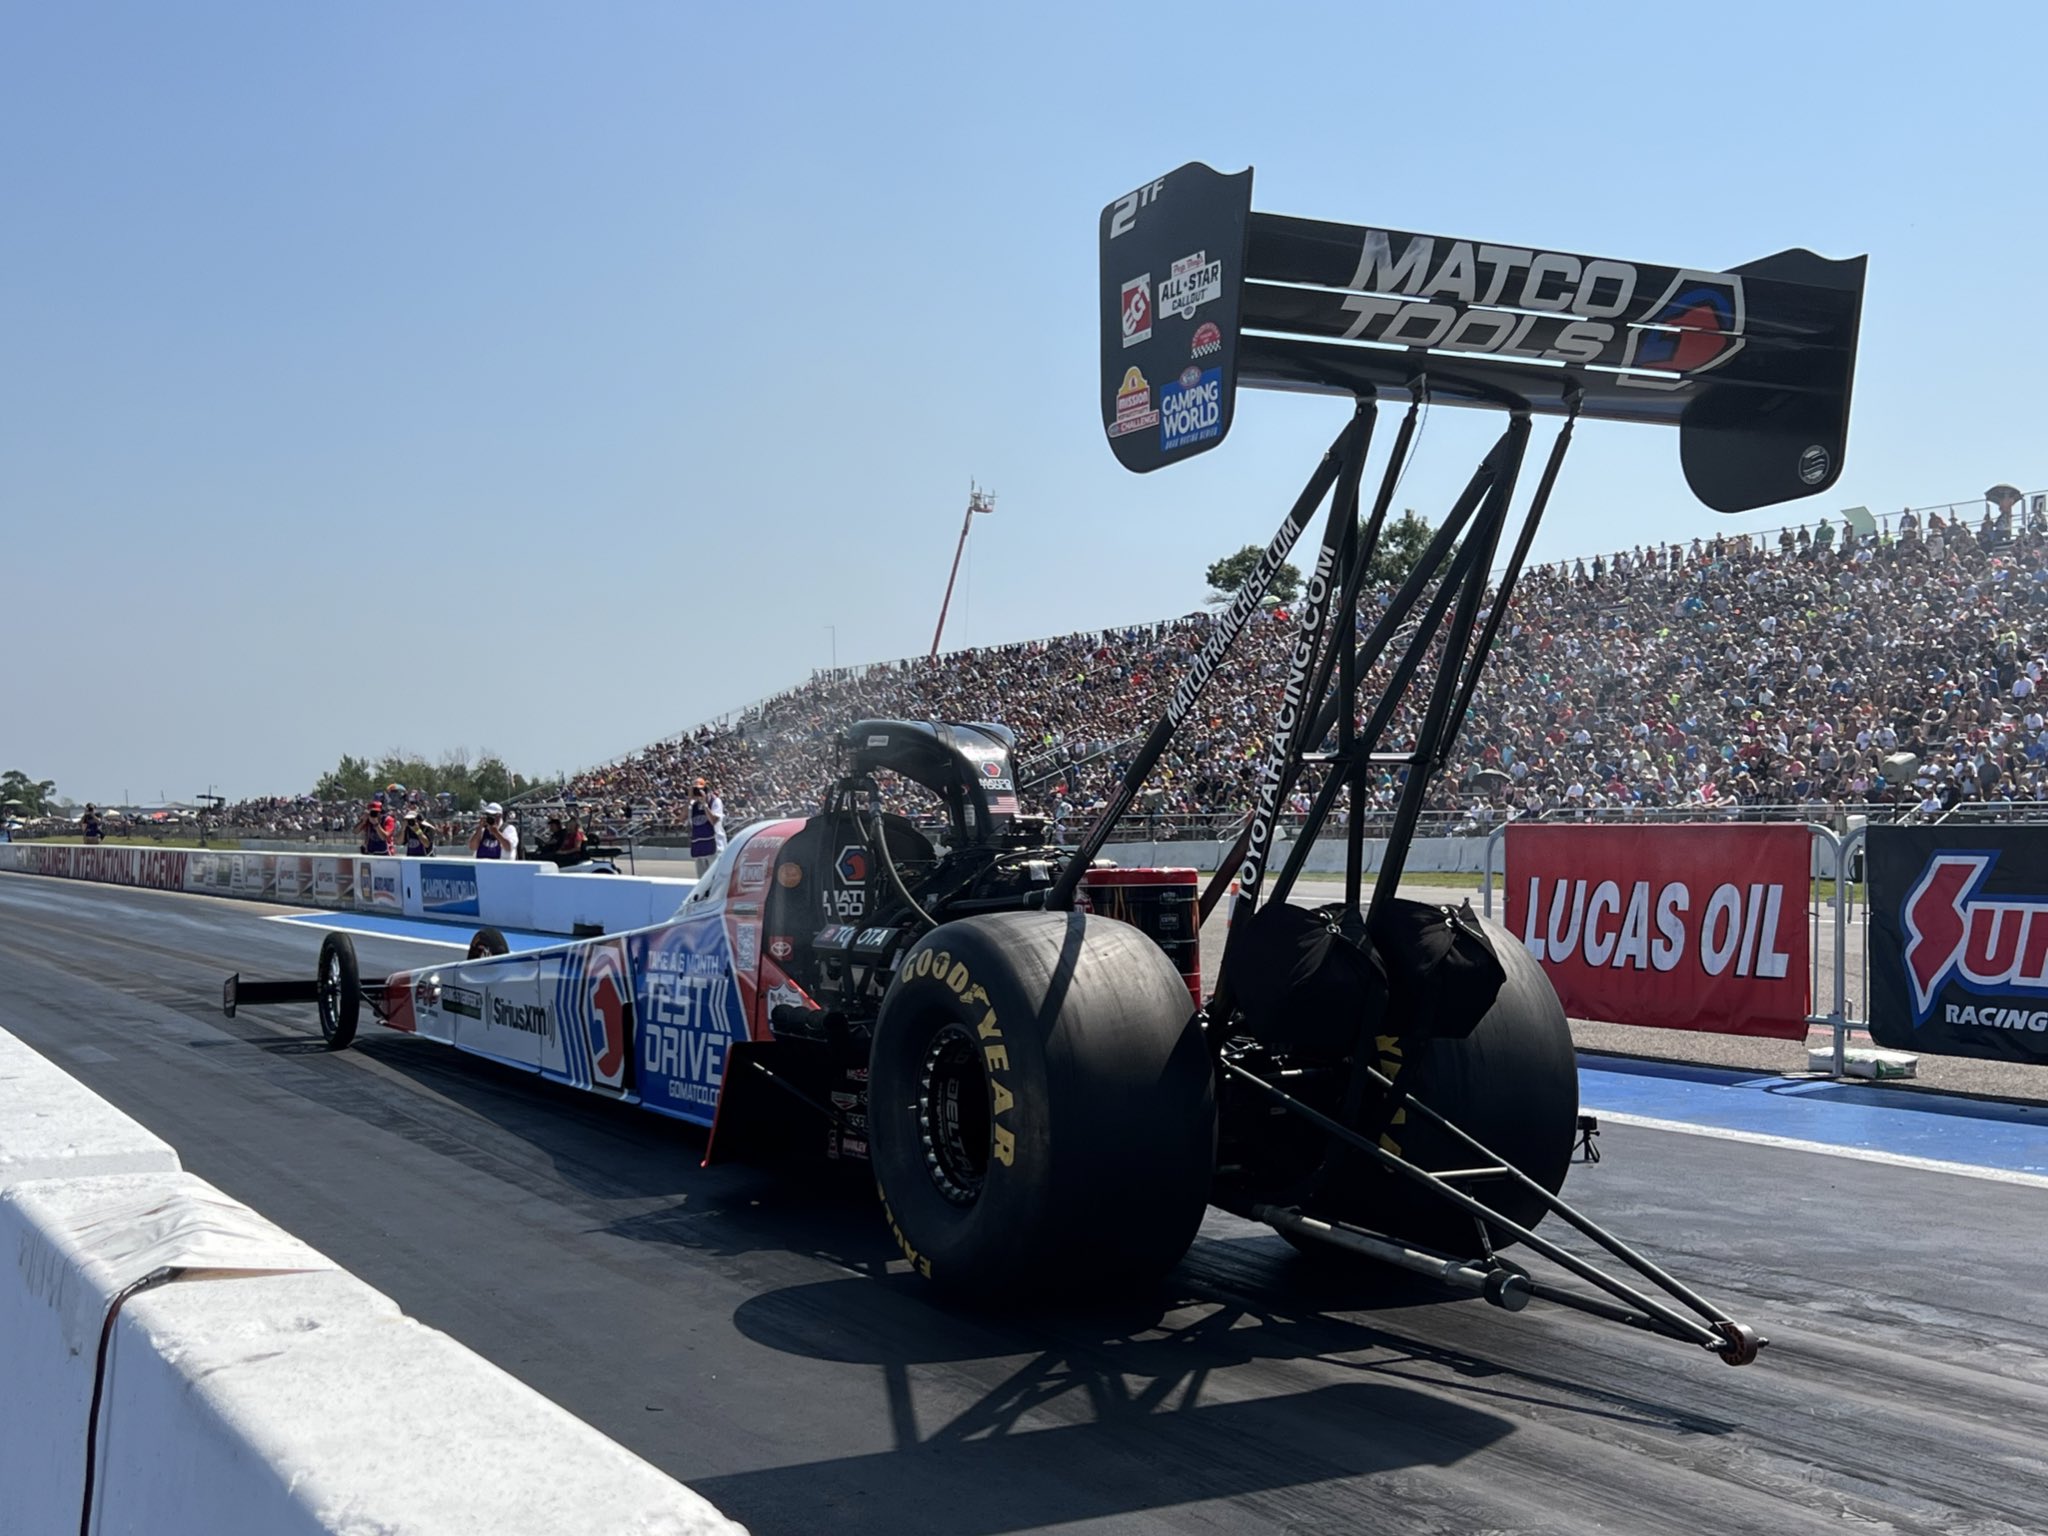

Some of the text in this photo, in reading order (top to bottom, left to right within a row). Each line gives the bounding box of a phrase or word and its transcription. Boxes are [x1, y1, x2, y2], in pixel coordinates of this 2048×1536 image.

[1110, 177, 1165, 240] 2 TF
[1350, 229, 1638, 319] MATCO
[1172, 288, 1206, 311] CALLOUT
[1340, 295, 1616, 364] TOOLS
[1162, 380, 1219, 416] CAMPING
[1163, 402, 1219, 439] WORLD
[1167, 515, 1300, 728] MATCOFRANCHISE.COM
[1238, 544, 1336, 900] TOYOTARACING.COM
[139, 849, 188, 890] RACEWAY
[421, 878, 478, 901] CAMPING WORLD
[1525, 876, 1789, 978] LUCAS OIL
[648, 950, 669, 971] TAKE
[687, 954, 720, 976] MONTH
[645, 972, 708, 1029] TEST
[1945, 1003, 2048, 1032] RACING
[901, 948, 1016, 1167] GOODYEAR
[669, 1079, 721, 1108] GOMATCO.CO
